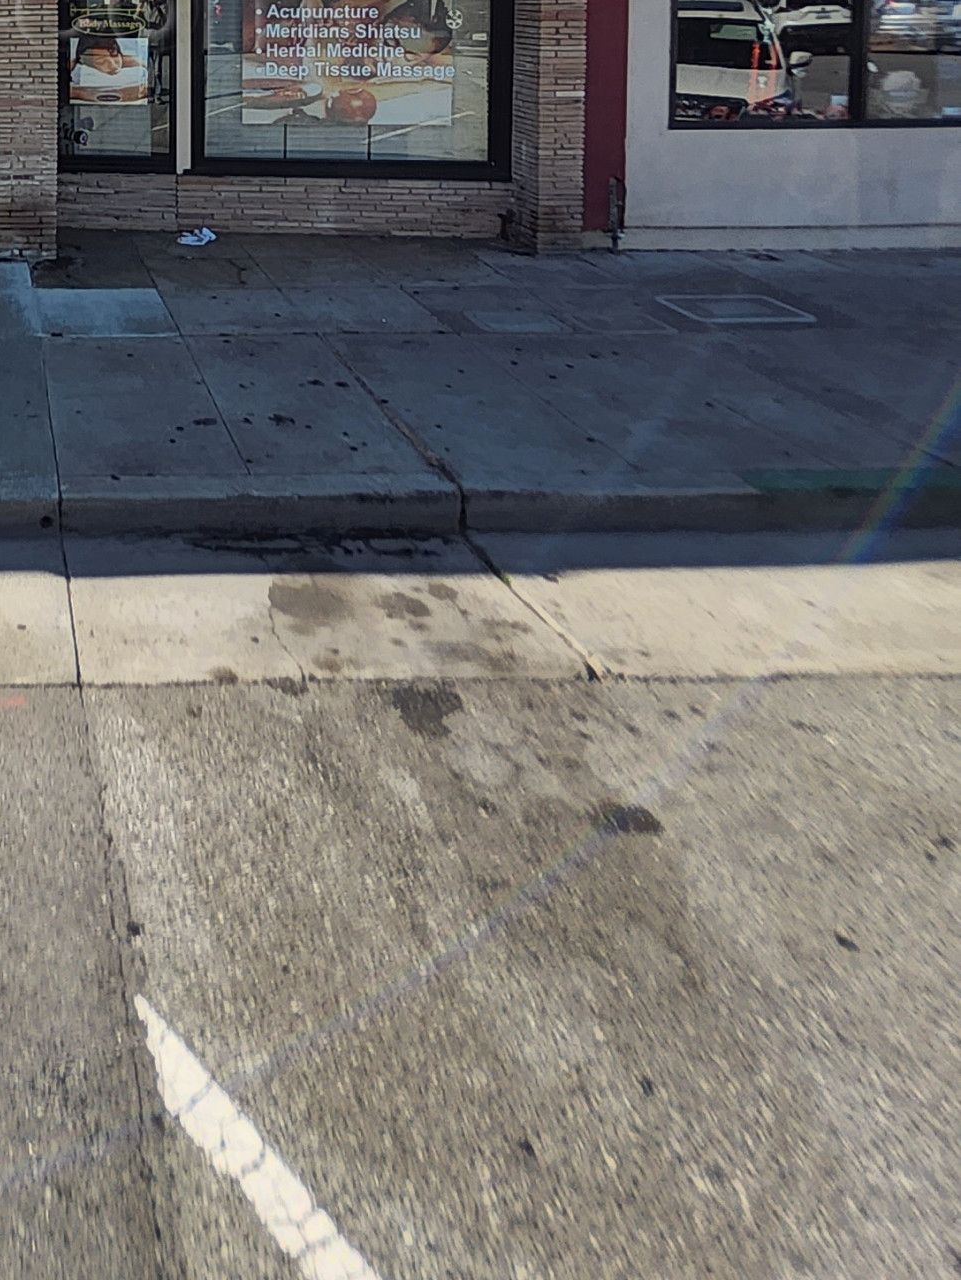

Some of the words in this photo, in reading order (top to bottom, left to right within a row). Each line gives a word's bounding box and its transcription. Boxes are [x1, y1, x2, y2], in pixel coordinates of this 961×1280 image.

[266, 4, 379, 21] Acupuncture
[266, 24, 350, 39] Meridians
[355, 24, 421, 39] Shiatsu
[266, 43, 321, 58] Herbal
[327, 43, 405, 58] Medicine
[266, 62, 309, 81] Deep
[314, 62, 371, 77] Tissue
[376, 63, 456, 80] Massage
